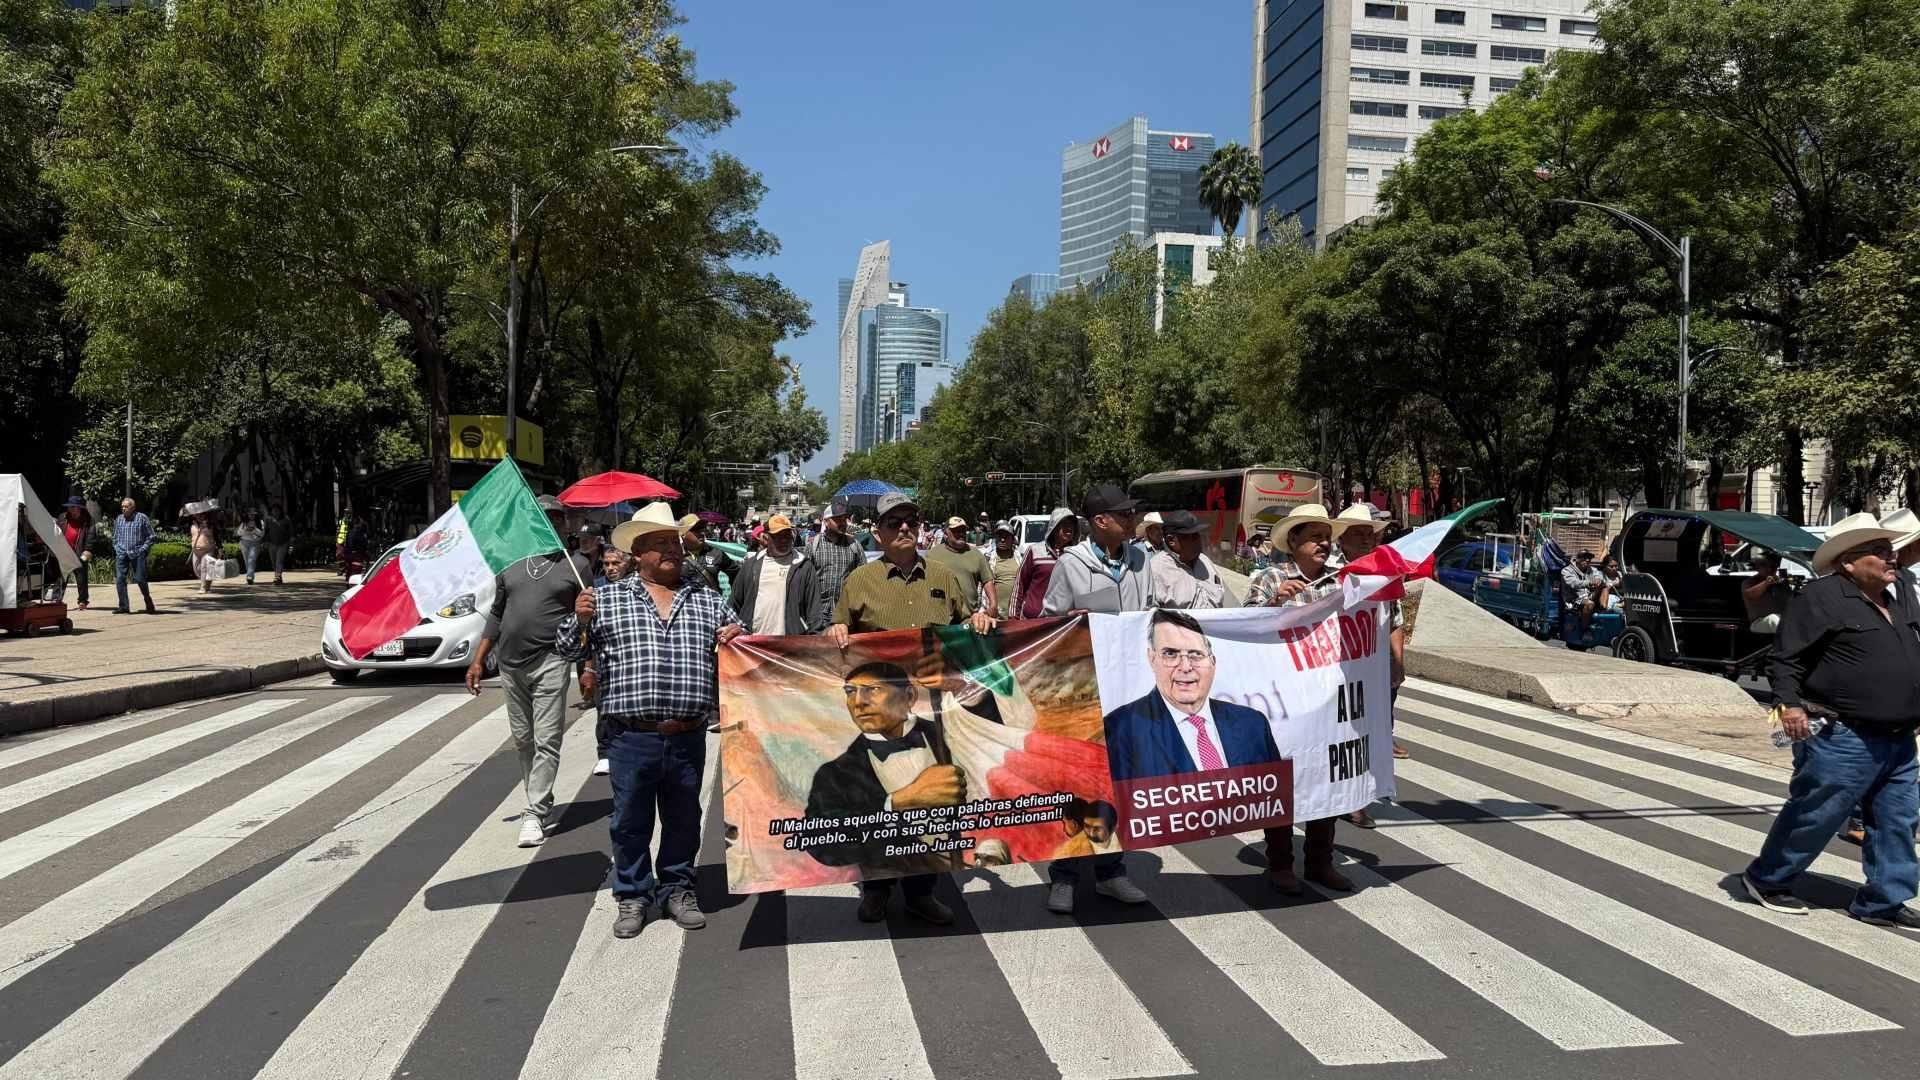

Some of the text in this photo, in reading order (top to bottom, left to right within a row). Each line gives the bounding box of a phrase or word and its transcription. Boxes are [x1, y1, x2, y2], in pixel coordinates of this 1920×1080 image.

[1337, 680, 1365, 723] A LA
[1132, 773, 1278, 810] SECRETARIO
[783, 817, 840, 833] Malditos
[843, 811, 899, 828] aquellos
[903, 809, 927, 823] que
[930, 806, 954, 819] con
[957, 799, 1012, 816] palabras
[1015, 792, 1073, 809] defienden
[785, 807, 1063, 849] al pueblo... y con sus hechos lo traicionan!!
[1129, 795, 1285, 838] DE ECONOMÍA
[885, 837, 975, 856] Benito Juárez
